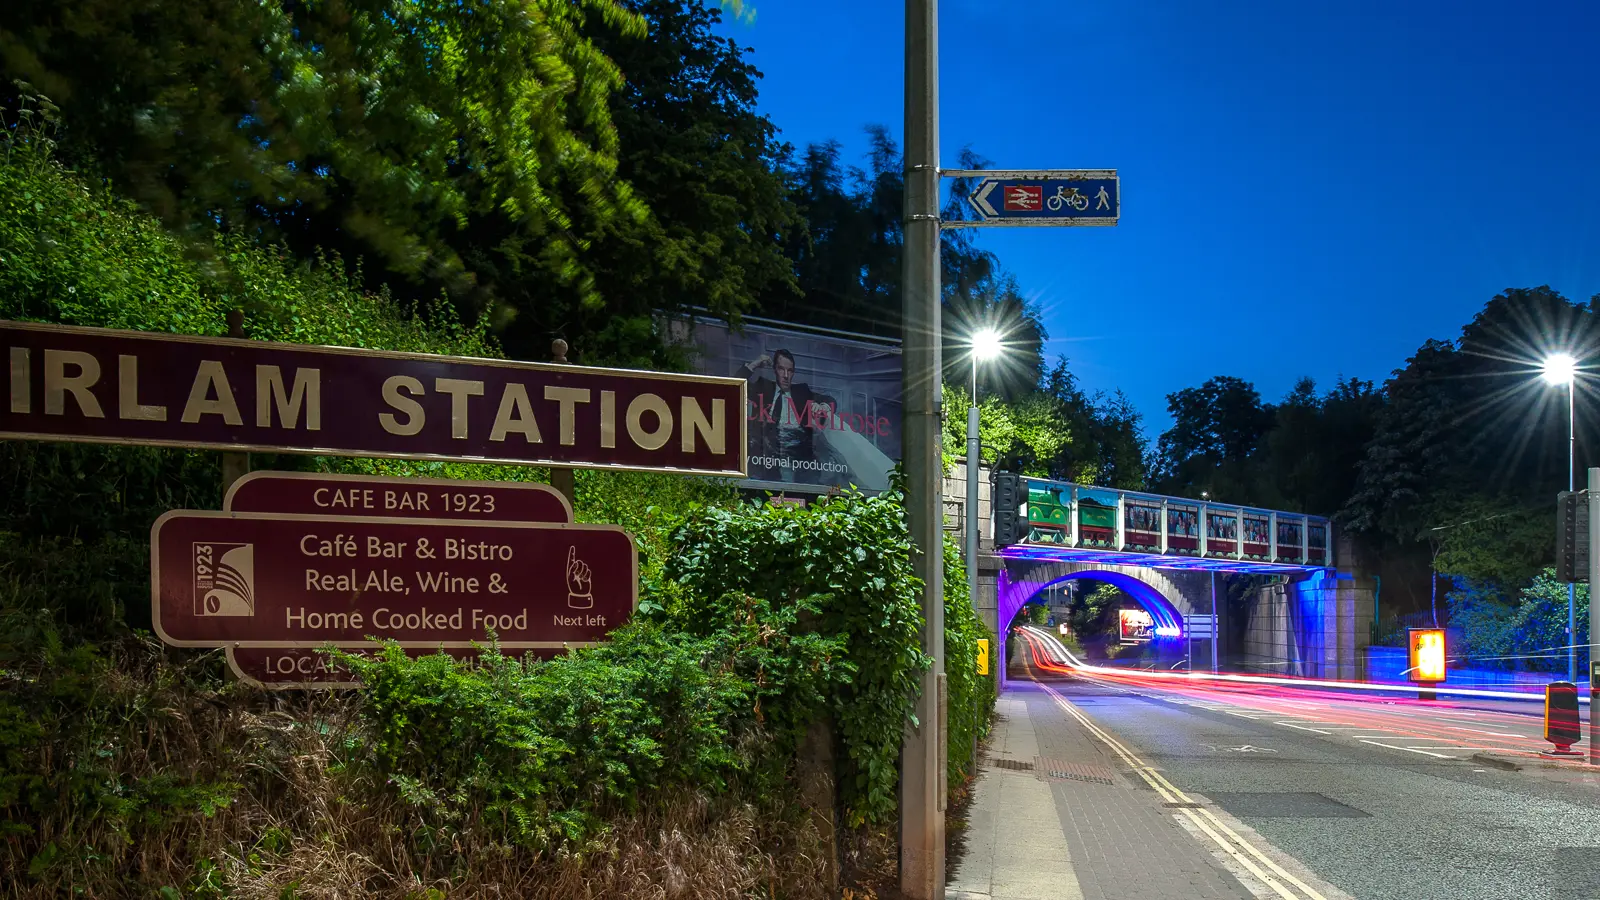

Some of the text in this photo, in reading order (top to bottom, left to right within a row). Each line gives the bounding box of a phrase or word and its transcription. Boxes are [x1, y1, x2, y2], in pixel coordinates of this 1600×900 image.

[10, 347, 726, 455] IRLAM STATION
[785, 396, 890, 437] Melrose
[751, 454, 790, 470] original
[792, 459, 848, 474] production
[313, 487, 496, 513] CAFE BAR 1923
[300, 534, 513, 561] Café Bar & Bistro
[196, 545, 213, 581] 1923
[306, 569, 508, 596] Real Ale, Wine &
[286, 607, 528, 630] Home Cooked Food
[553, 614, 606, 627] Next left
[266, 656, 339, 675] LOCAL
